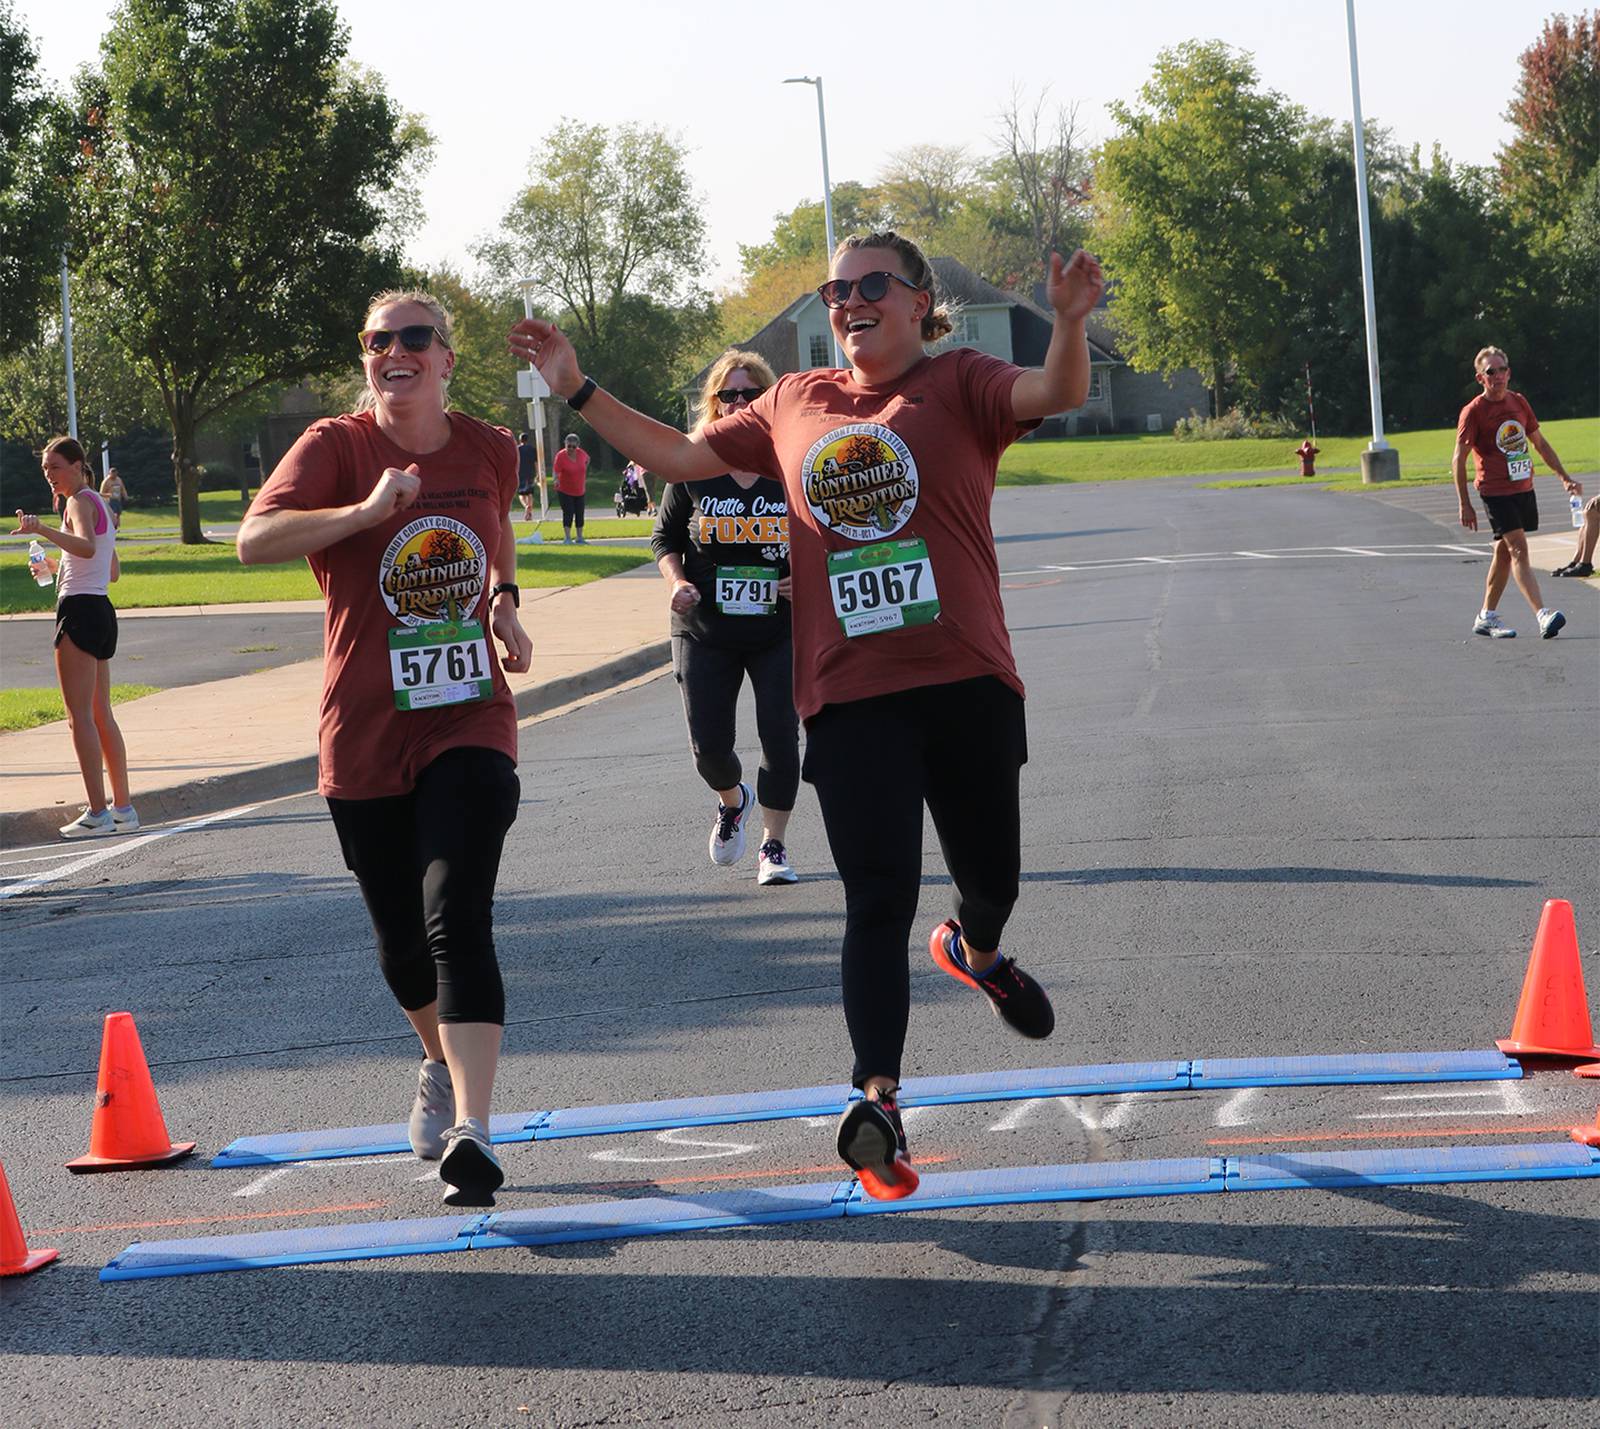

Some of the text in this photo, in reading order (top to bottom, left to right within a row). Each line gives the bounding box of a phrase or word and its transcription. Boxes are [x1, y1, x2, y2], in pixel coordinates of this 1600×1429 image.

[803, 442, 824, 477] GRUNDY
[823, 425, 856, 445] COUNTY
[879, 427, 912, 461] FESTIVAL
[822, 456, 841, 477] A
[806, 460, 910, 505] CONTINUED
[700, 496, 745, 517] Nettle
[823, 479, 917, 528] TRADITION
[383, 517, 486, 569] GRUNDY COUNTY CORN FESTIVAL
[405, 553, 422, 571] A
[384, 558, 481, 596] CONTINUED
[395, 577, 484, 617] TRADITION
[721, 581, 772, 602] 5791
[838, 562, 923, 613] 5967
[400, 643, 483, 686] 5761
